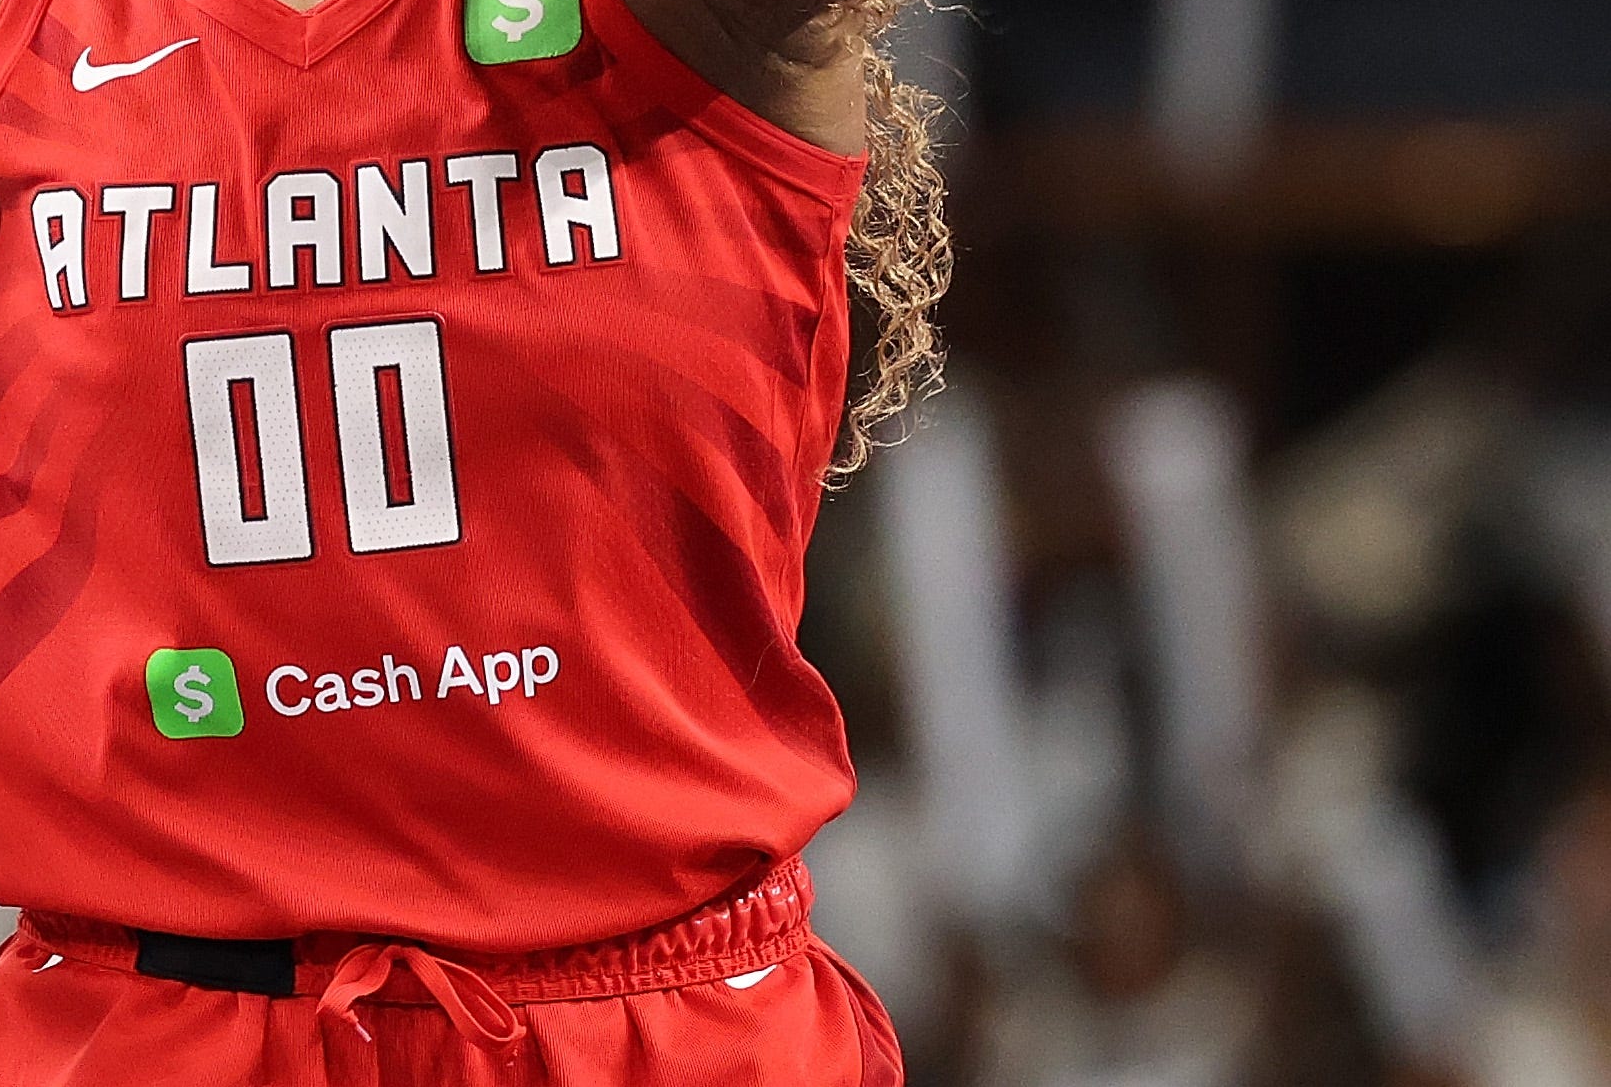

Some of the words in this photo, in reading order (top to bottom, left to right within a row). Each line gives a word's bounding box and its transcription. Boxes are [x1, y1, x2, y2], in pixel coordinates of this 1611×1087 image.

[30, 143, 622, 313] ATLANTA
[182, 318, 461, 568] 00
[265, 653, 423, 717] Cash
[438, 644, 560, 706] App
